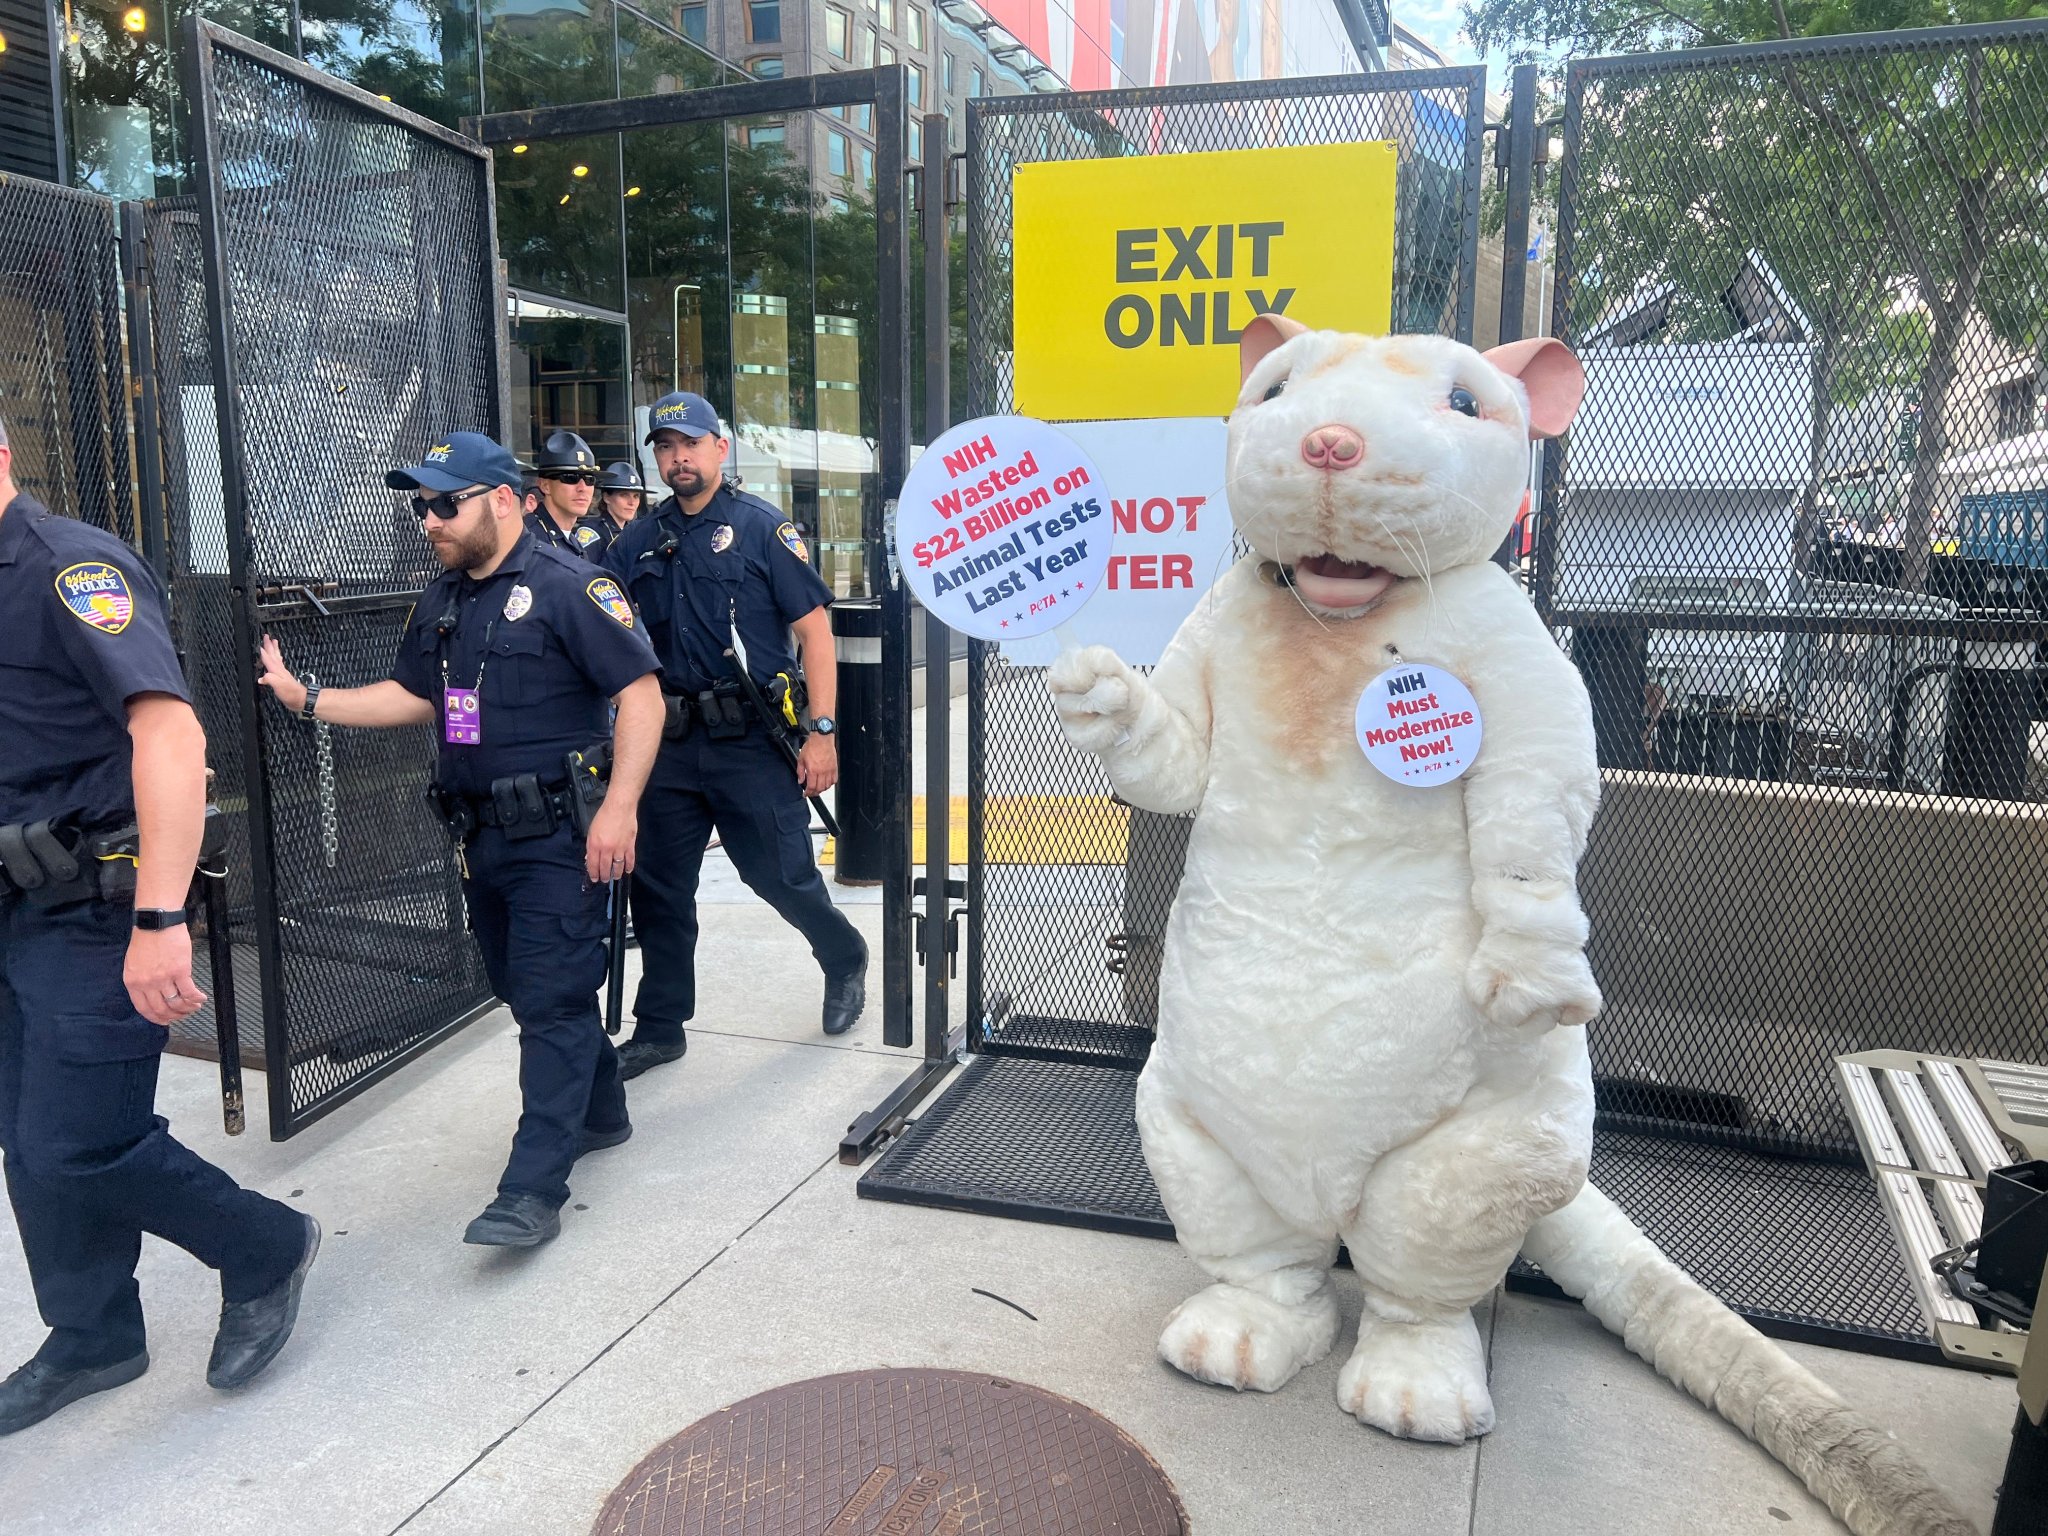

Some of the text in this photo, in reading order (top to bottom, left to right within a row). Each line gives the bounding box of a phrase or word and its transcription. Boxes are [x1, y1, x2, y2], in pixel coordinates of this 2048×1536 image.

[1115, 221, 1285, 284] EXIT
[655, 411, 688, 425] POLICE
[942, 434, 998, 479] NIH
[931, 450, 1040, 520] Wasted
[912, 466, 1091, 569] $22 Billion on
[1110, 496, 1207, 534] NOT
[932, 498, 1102, 598] Animal Tests
[70, 578, 119, 595] POLICE
[964, 538, 1088, 614] Last Year
[1107, 554, 1194, 590] TER
[598, 588, 619, 601] POLICE
[1386, 672, 1427, 696] NIH
[1386, 692, 1440, 719] Must
[1365, 711, 1474, 748] Modernize
[1399, 735, 1454, 763] Now!
[837, 1491, 873, 1529] FOUNDRY
[878, 1475, 940, 1536] ICATIONS
